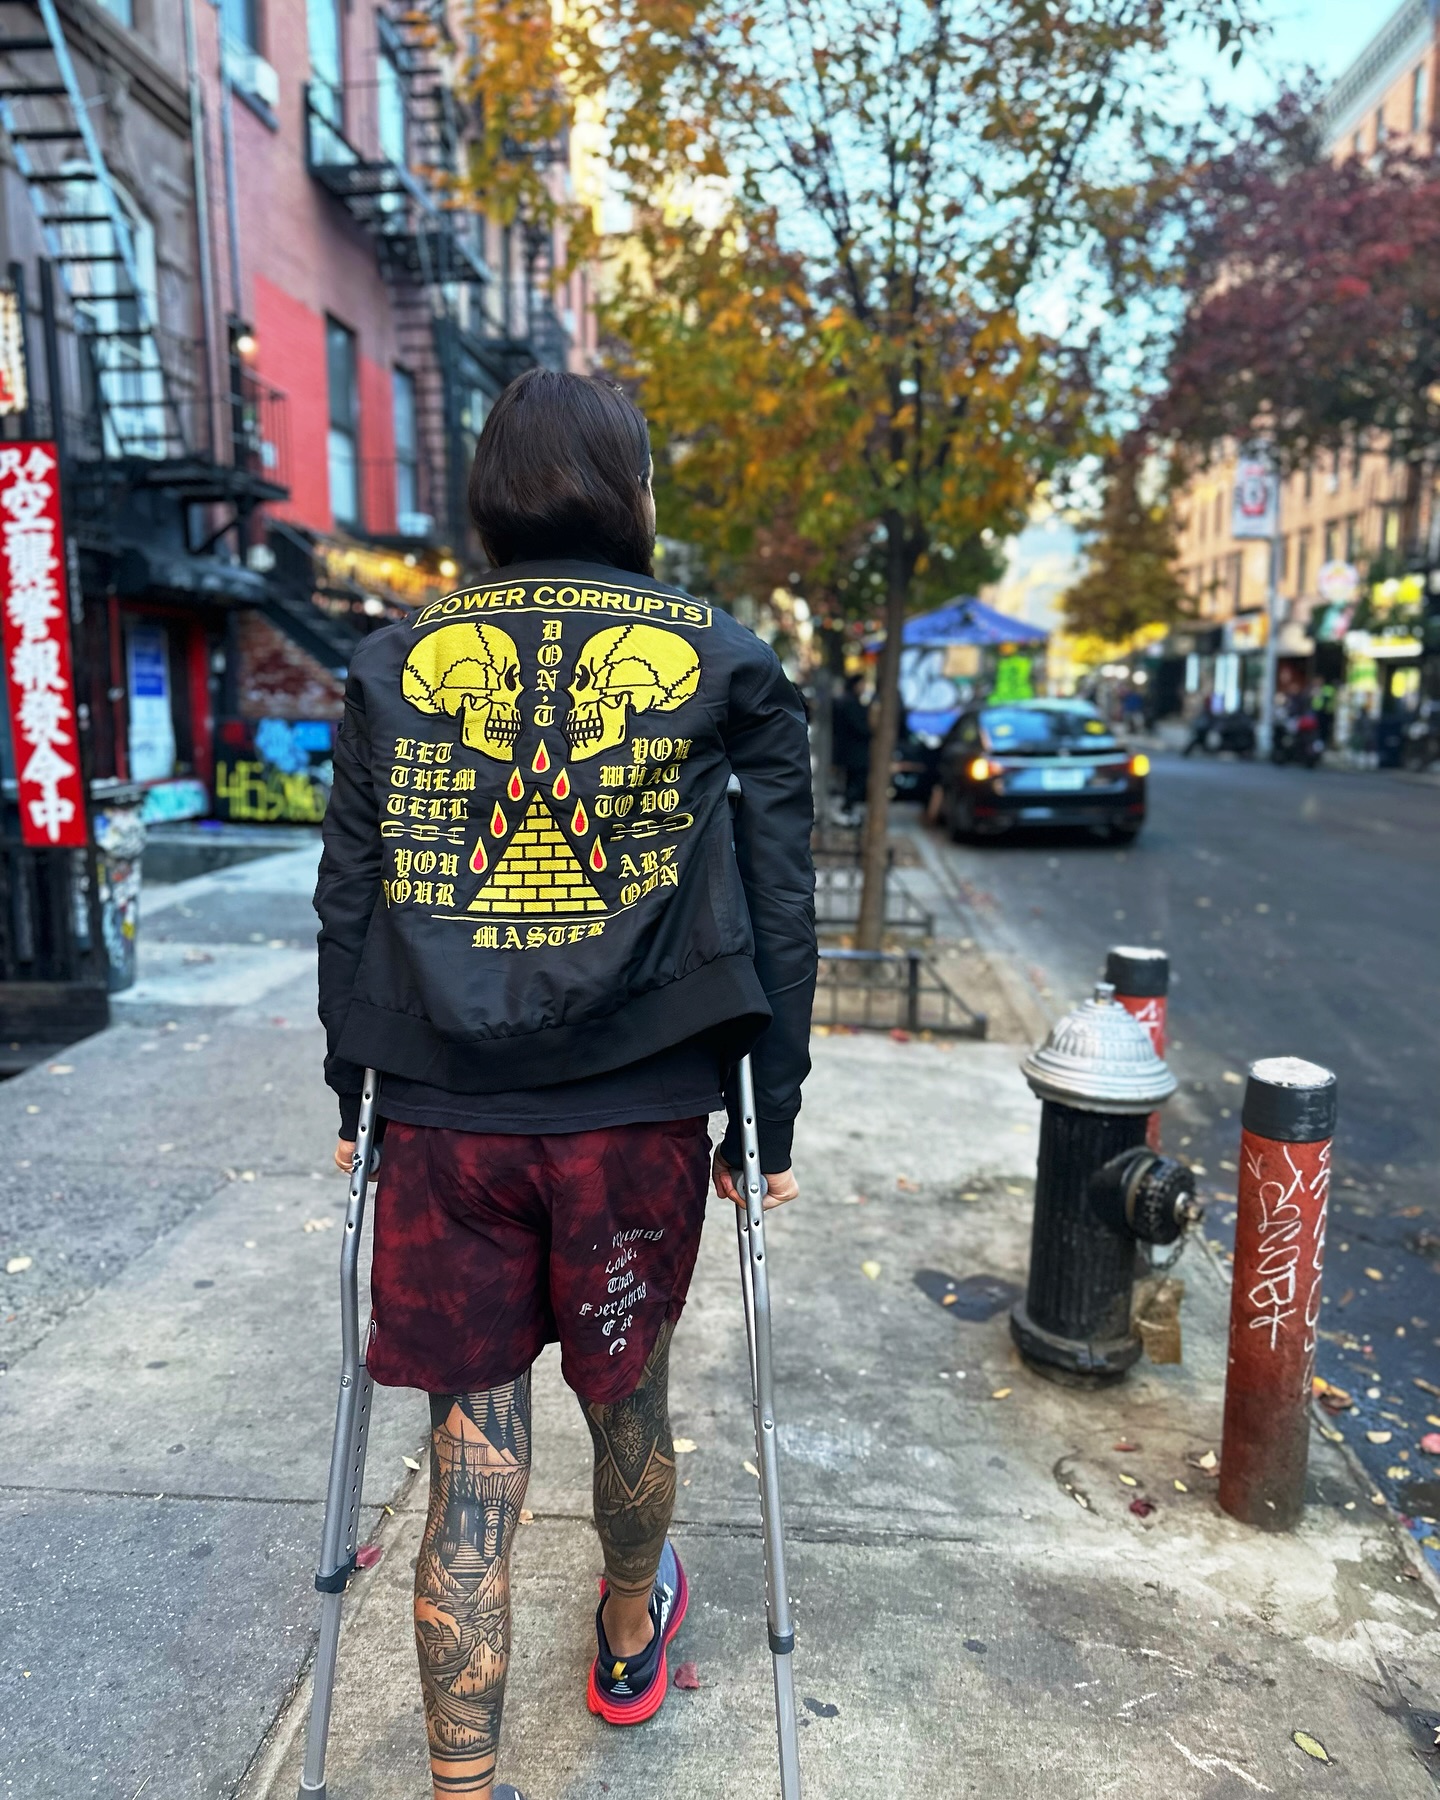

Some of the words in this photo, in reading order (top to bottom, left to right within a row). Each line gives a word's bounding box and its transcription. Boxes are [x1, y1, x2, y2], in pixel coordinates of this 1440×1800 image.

[424, 586, 526, 621] POWER
[532, 586, 704, 622] CORRUPTS
[533, 619, 563, 727] DON'T
[394, 737, 454, 765] LET
[631, 737, 693, 764] YOU
[390, 765, 477, 792] THEM
[598, 763, 682, 789] WHAT
[386, 793, 469, 821] TELL
[594, 794, 634, 819] TO
[640, 788, 680, 815] DO
[394, 848, 460, 879] YOU
[620, 861, 679, 906] OWN
[471, 921, 606, 951] MASTER
